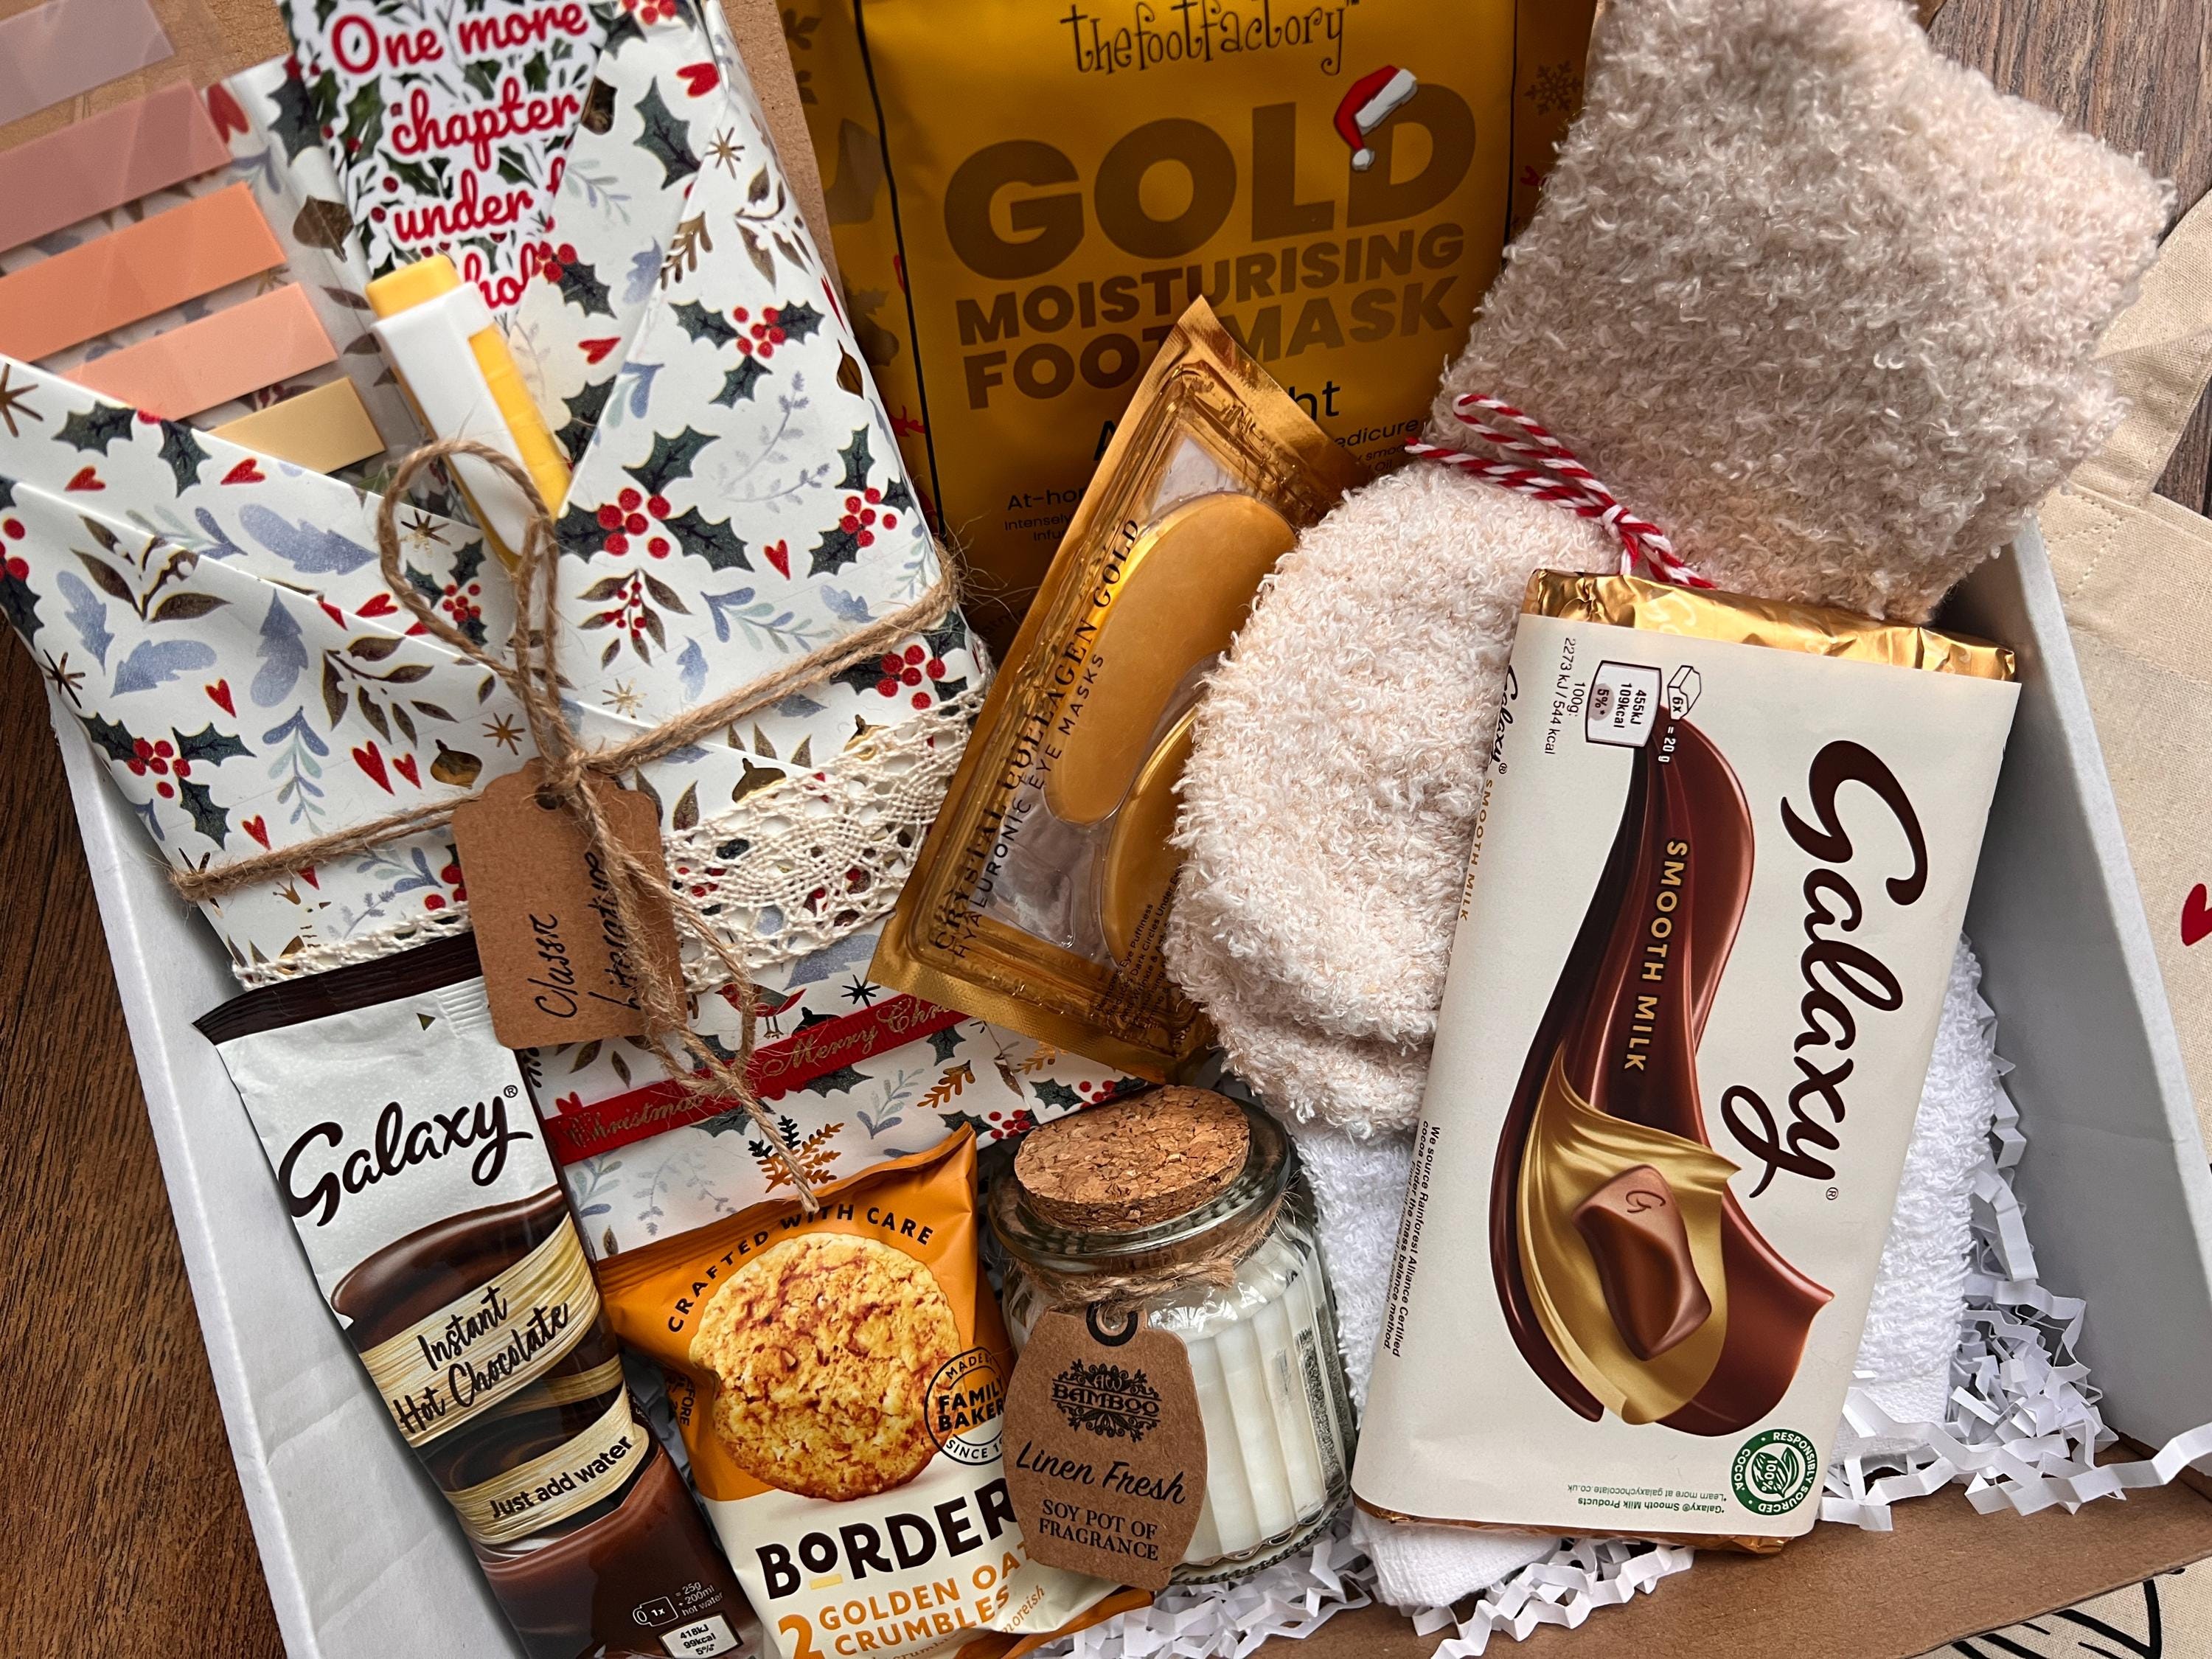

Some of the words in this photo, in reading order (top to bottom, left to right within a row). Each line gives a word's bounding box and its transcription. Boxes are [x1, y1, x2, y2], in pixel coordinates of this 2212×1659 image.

[332, 15, 443, 74] One
[459, 4, 588, 54] more
[392, 77, 580, 171] chapter
[944, 83, 1475, 280] GOLD
[394, 168, 533, 242] under
[955, 223, 1464, 347] MOISTURISING
[1221, 276, 1458, 363] MASK
[1374, 460, 1393, 473] Oil
[1560, 636, 1577, 672] 2273
[1555, 673, 1571, 690] kJ
[1568, 681, 1587, 717] 100g:
[1551, 700, 1566, 726] 544
[1613, 682, 1633, 728] 109kcal
[1630, 689, 1648, 726] 455kJ
[1672, 695, 1685, 714] 6x
[933, 804, 1007, 951] CRYSTAL
[996, 618, 1099, 792] COLLAGEN
[1092, 519, 1140, 608] GOLD
[1544, 728, 1562, 756] kcal
[1663, 736, 1677, 753] 20
[951, 796, 1032, 959] HYALURONIC
[1028, 744, 1062, 790] EYE
[1057, 653, 1105, 736] MASKS
[1471, 778, 1494, 866] SMOOTH
[1460, 873, 1475, 922] MILK
[1641, 840, 1688, 983] SMOOTH
[1119, 950, 1134, 968] Eye
[1130, 902, 1154, 949] Puffiness
[1130, 953, 1146, 976] Dark
[1142, 918, 1161, 952] Circles
[1155, 890, 1175, 918] Under
[1132, 962, 1155, 999] Wrinkle
[762, 1023, 879, 1077] Merry
[1624, 994, 1659, 1071] MILK
[1416, 1120, 1429, 1157] cocoa
[1428, 1125, 1441, 1146] We
[1410, 1159, 1423, 1196] under
[1421, 1147, 1435, 1190] source
[1407, 1197, 1416, 1217] the
[1411, 1191, 1429, 1254] Rainforest
[1400, 1220, 1412, 1253] mass
[667, 1230, 770, 1334] CRAFTED
[779, 1203, 855, 1231] WITH
[866, 1206, 934, 1246] CARE
[1391, 1253, 1407, 1301] balance
[1401, 1254, 1418, 1304] Alliance
[417, 1286, 507, 1371] Instant
[1382, 1302, 1398, 1351] method.
[1391, 1306, 1409, 1358] Certified
[392, 1386, 446, 1434] Hot
[448, 1301, 569, 1408] Chocolate
[945, 1352, 982, 1380] MADE
[938, 1374, 1004, 1416] FAMILY
[1052, 1381, 1161, 1416] BAMBOO
[945, 1439, 989, 1460] SINCE
[1773, 1431, 1817, 1484] RESPONSIBLY
[488, 1489, 532, 1520] Just
[537, 1472, 576, 1503] add
[575, 1435, 635, 1486] water
[1015, 1440, 1096, 1485] Linen
[1101, 1460, 1186, 1505] Fresh
[1567, 1483, 1663, 1497] galaxychocolate.co.uk
[1664, 1489, 1674, 1498] at
[1761, 1459, 1778, 1491] 100%
[1577, 1498, 1621, 1509] Products
[1622, 1500, 1642, 1510] Milk
[1644, 1500, 1680, 1512] Smooth
[1675, 1489, 1698, 1500] more
[1758, 1485, 1809, 1513] SOURCED
[754, 1477, 1019, 1599] BORDER
[1038, 1517, 1160, 1561] FRAGRANCE
[1041, 1498, 1082, 1523] SOY
[1086, 1509, 1126, 1534] POT
[1130, 1519, 1158, 1540] OF
[681, 1604, 699, 1617] hot
[700, 1592, 723, 1610] water
[682, 1582, 702, 1595] 25g
[685, 1585, 714, 1604] 200ml
[819, 1576, 960, 1631] GOLDEN
[1003, 1585, 1046, 1634] moreish
[651, 1608, 666, 1616] 1x
[680, 1623, 710, 1640] 418kJ
[834, 1584, 1011, 1657] CRUMBLES
[683, 1632, 717, 1649] 99kcal
[778, 1613, 824, 1659] 2
